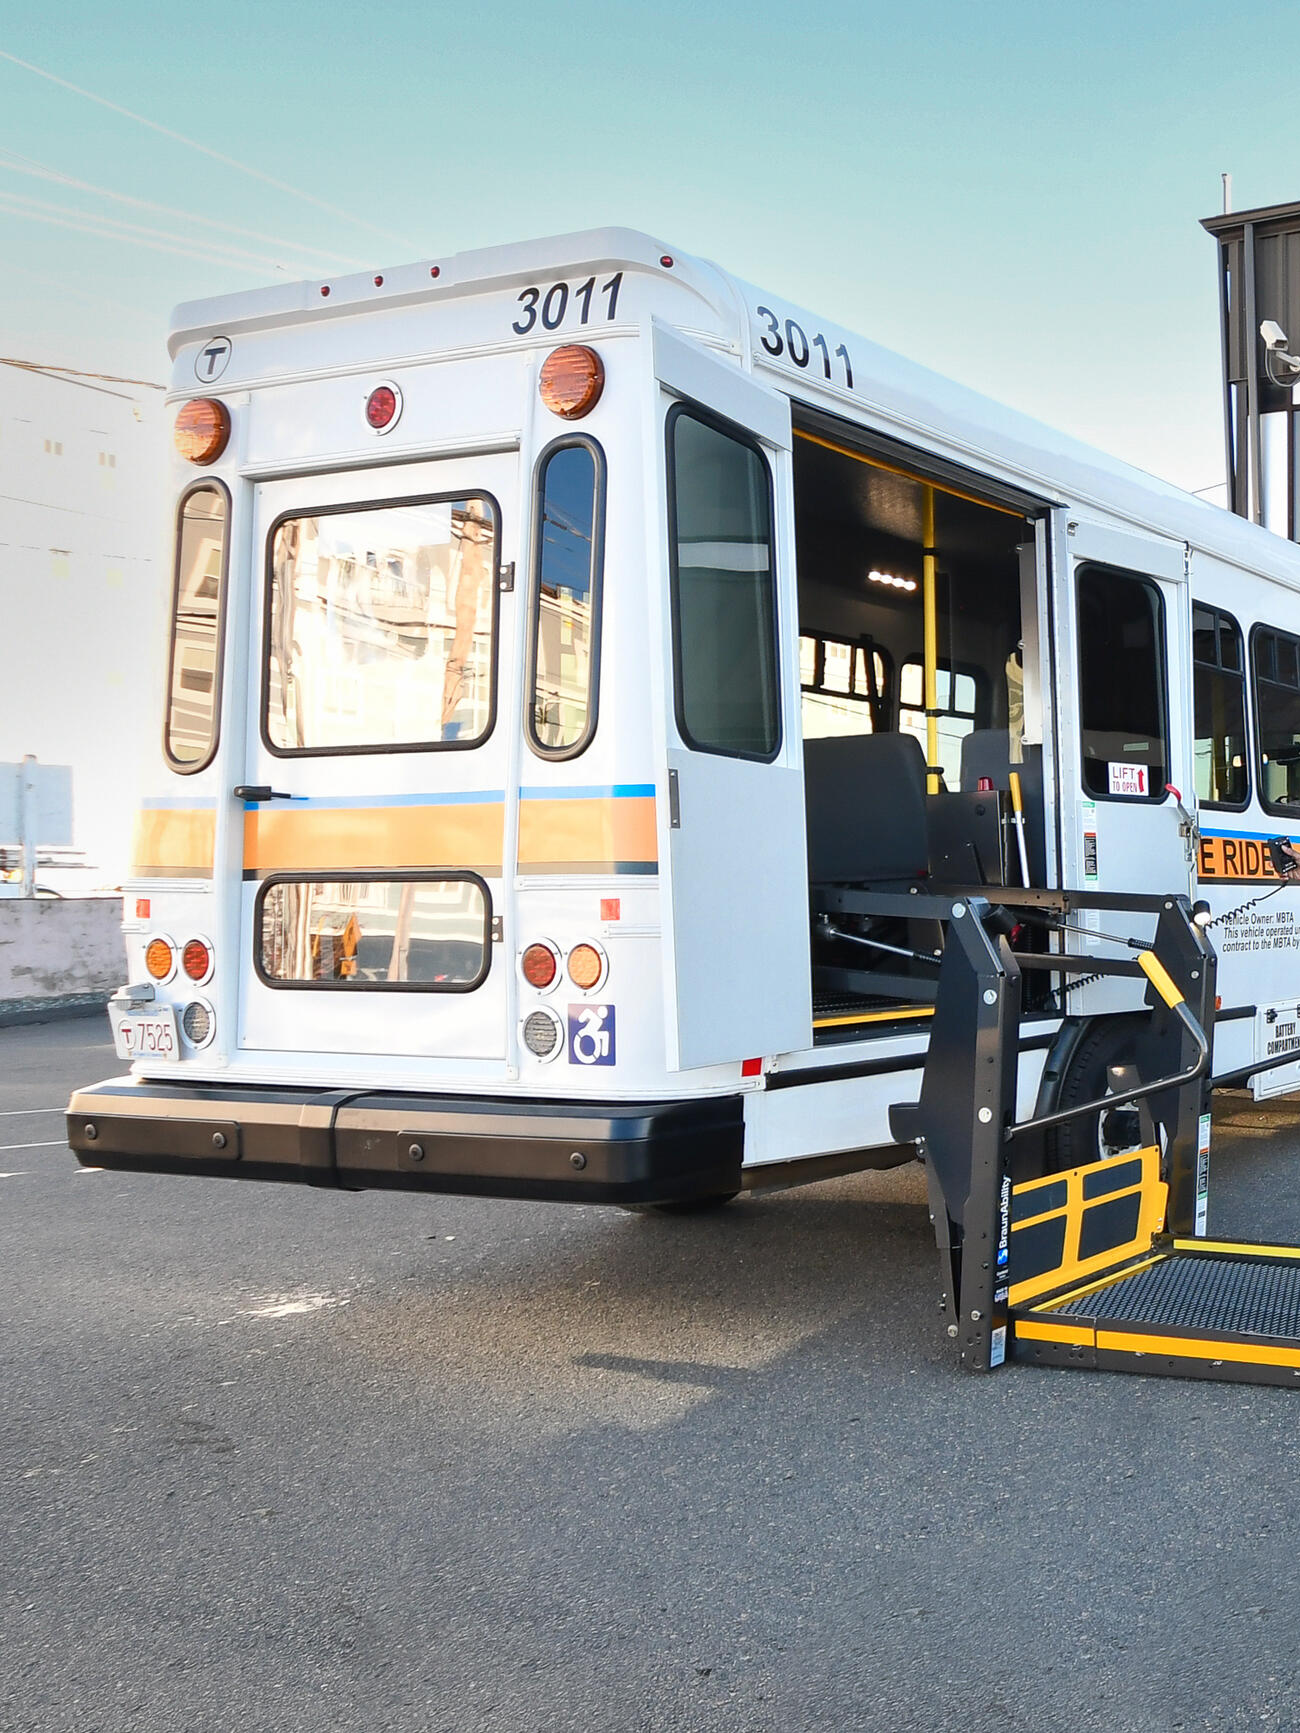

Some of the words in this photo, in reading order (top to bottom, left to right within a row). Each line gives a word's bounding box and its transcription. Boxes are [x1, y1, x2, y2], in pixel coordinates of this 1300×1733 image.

[511, 272, 624, 335] 3011
[756, 305, 855, 390] 3011
[1112, 766, 1135, 780] LIFT
[1112, 780, 1121, 792] TO
[1122, 781, 1138, 793] OPEN
[1198, 838, 1216, 875] E
[1222, 839, 1275, 876] RIDE
[1275, 911, 1294, 924] MBTA
[1224, 926, 1239, 940] This
[1240, 926, 1265, 938] vehicle
[1265, 924, 1294, 940] operated
[1222, 939, 1252, 953] contract
[1252, 940, 1260, 950] to
[1260, 938, 1272, 950] the
[1272, 936, 1292, 950] MBTA
[137, 1023, 173, 1051] 7525
[1276, 1022, 1296, 1038] BATTERY
[999, 1175, 1012, 1250] BraunAbility
